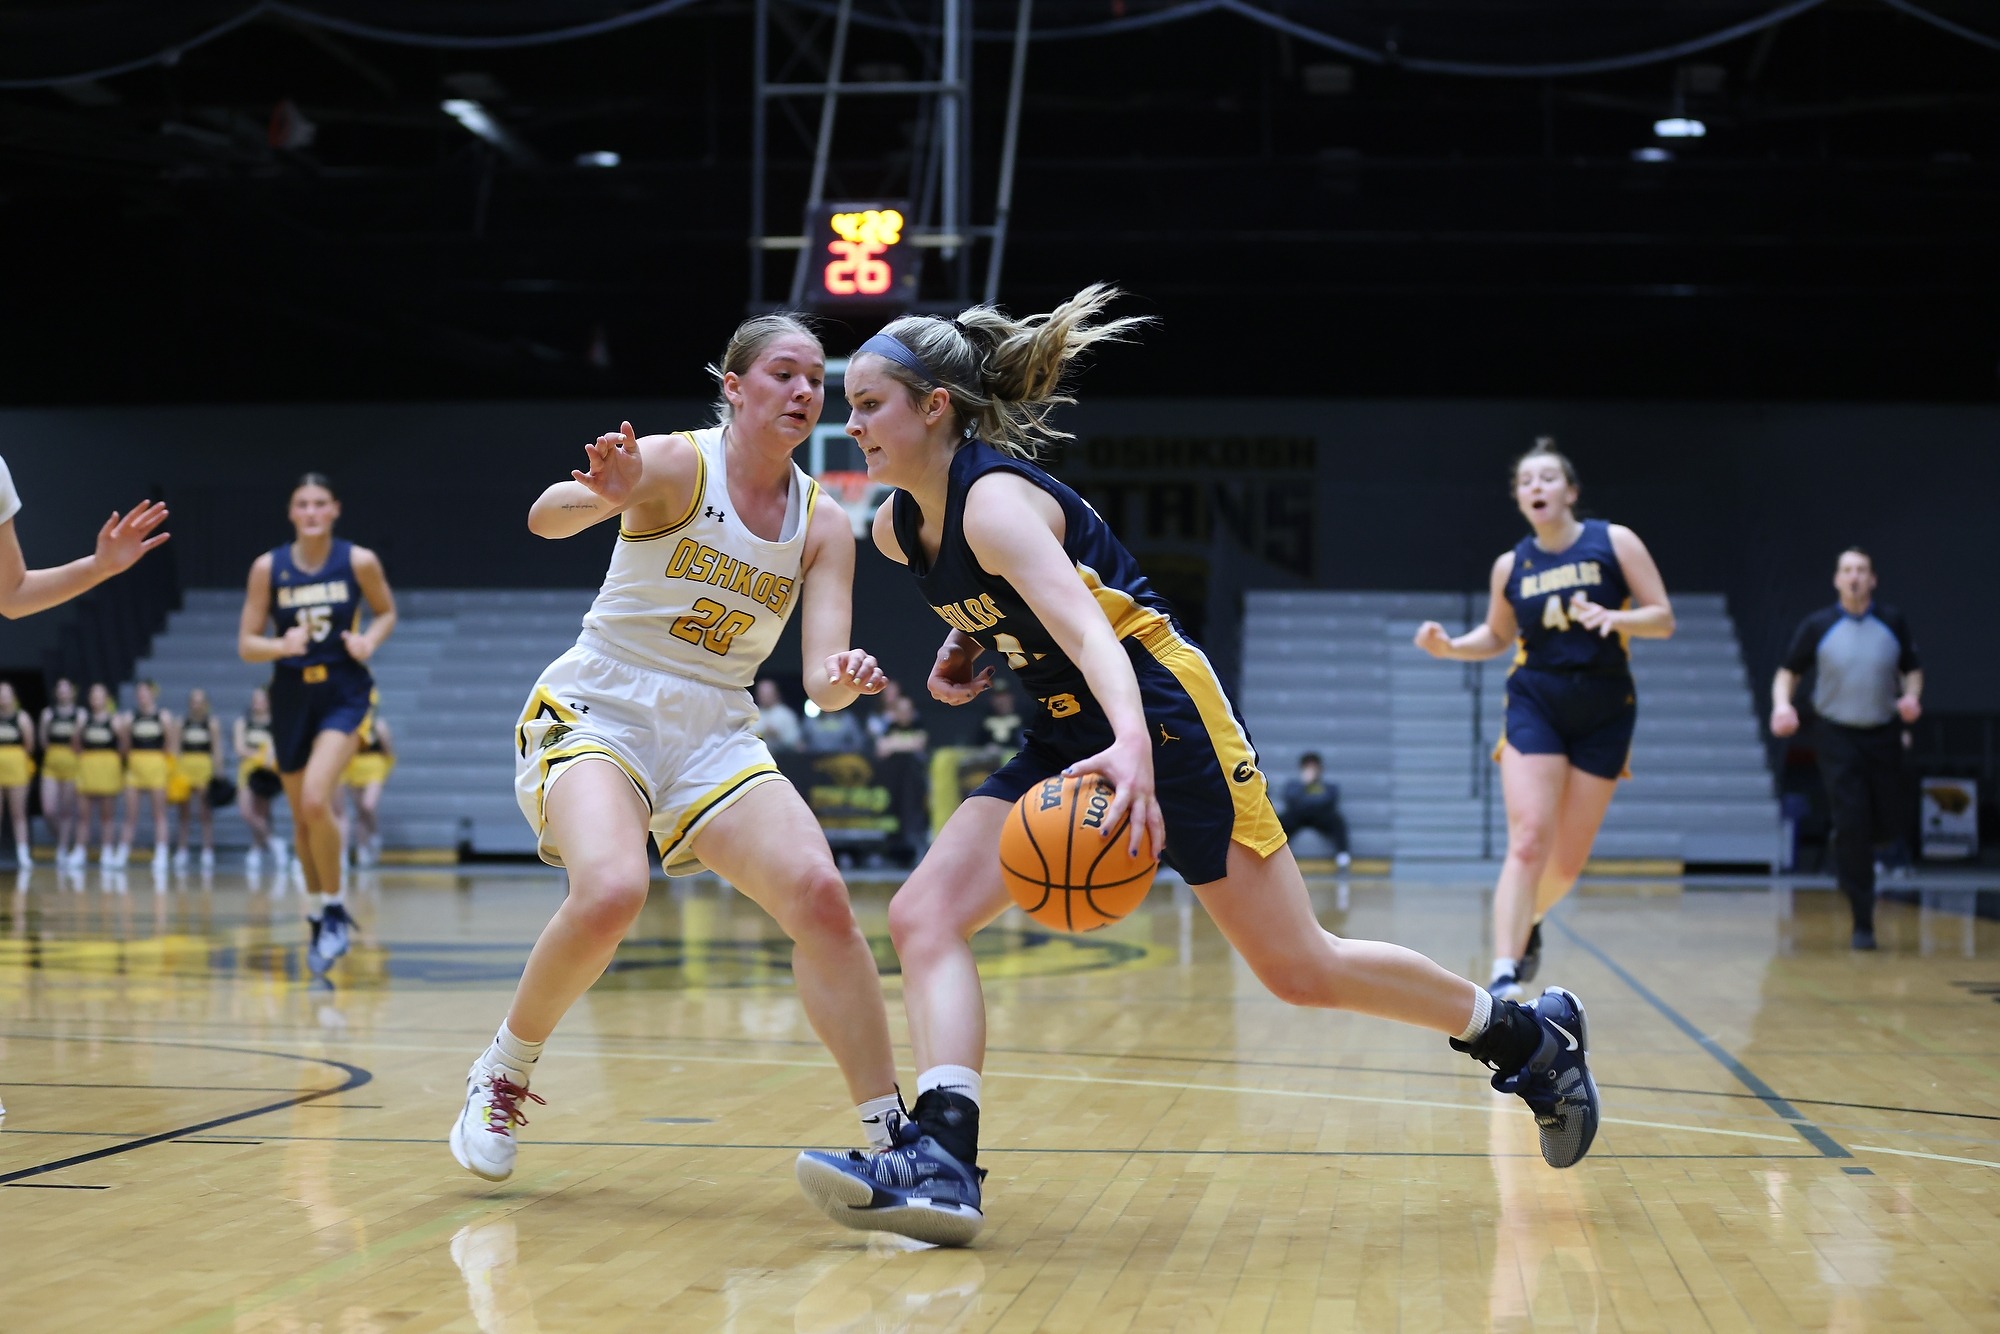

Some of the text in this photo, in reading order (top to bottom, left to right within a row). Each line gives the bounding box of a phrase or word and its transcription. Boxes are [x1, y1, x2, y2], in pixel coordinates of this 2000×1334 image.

[825, 241, 891, 295] 26
[1072, 480, 1315, 580] TANS
[665, 537, 795, 617] OSHKOS
[669, 597, 755, 656] 20
[1083, 779, 1113, 829] son
